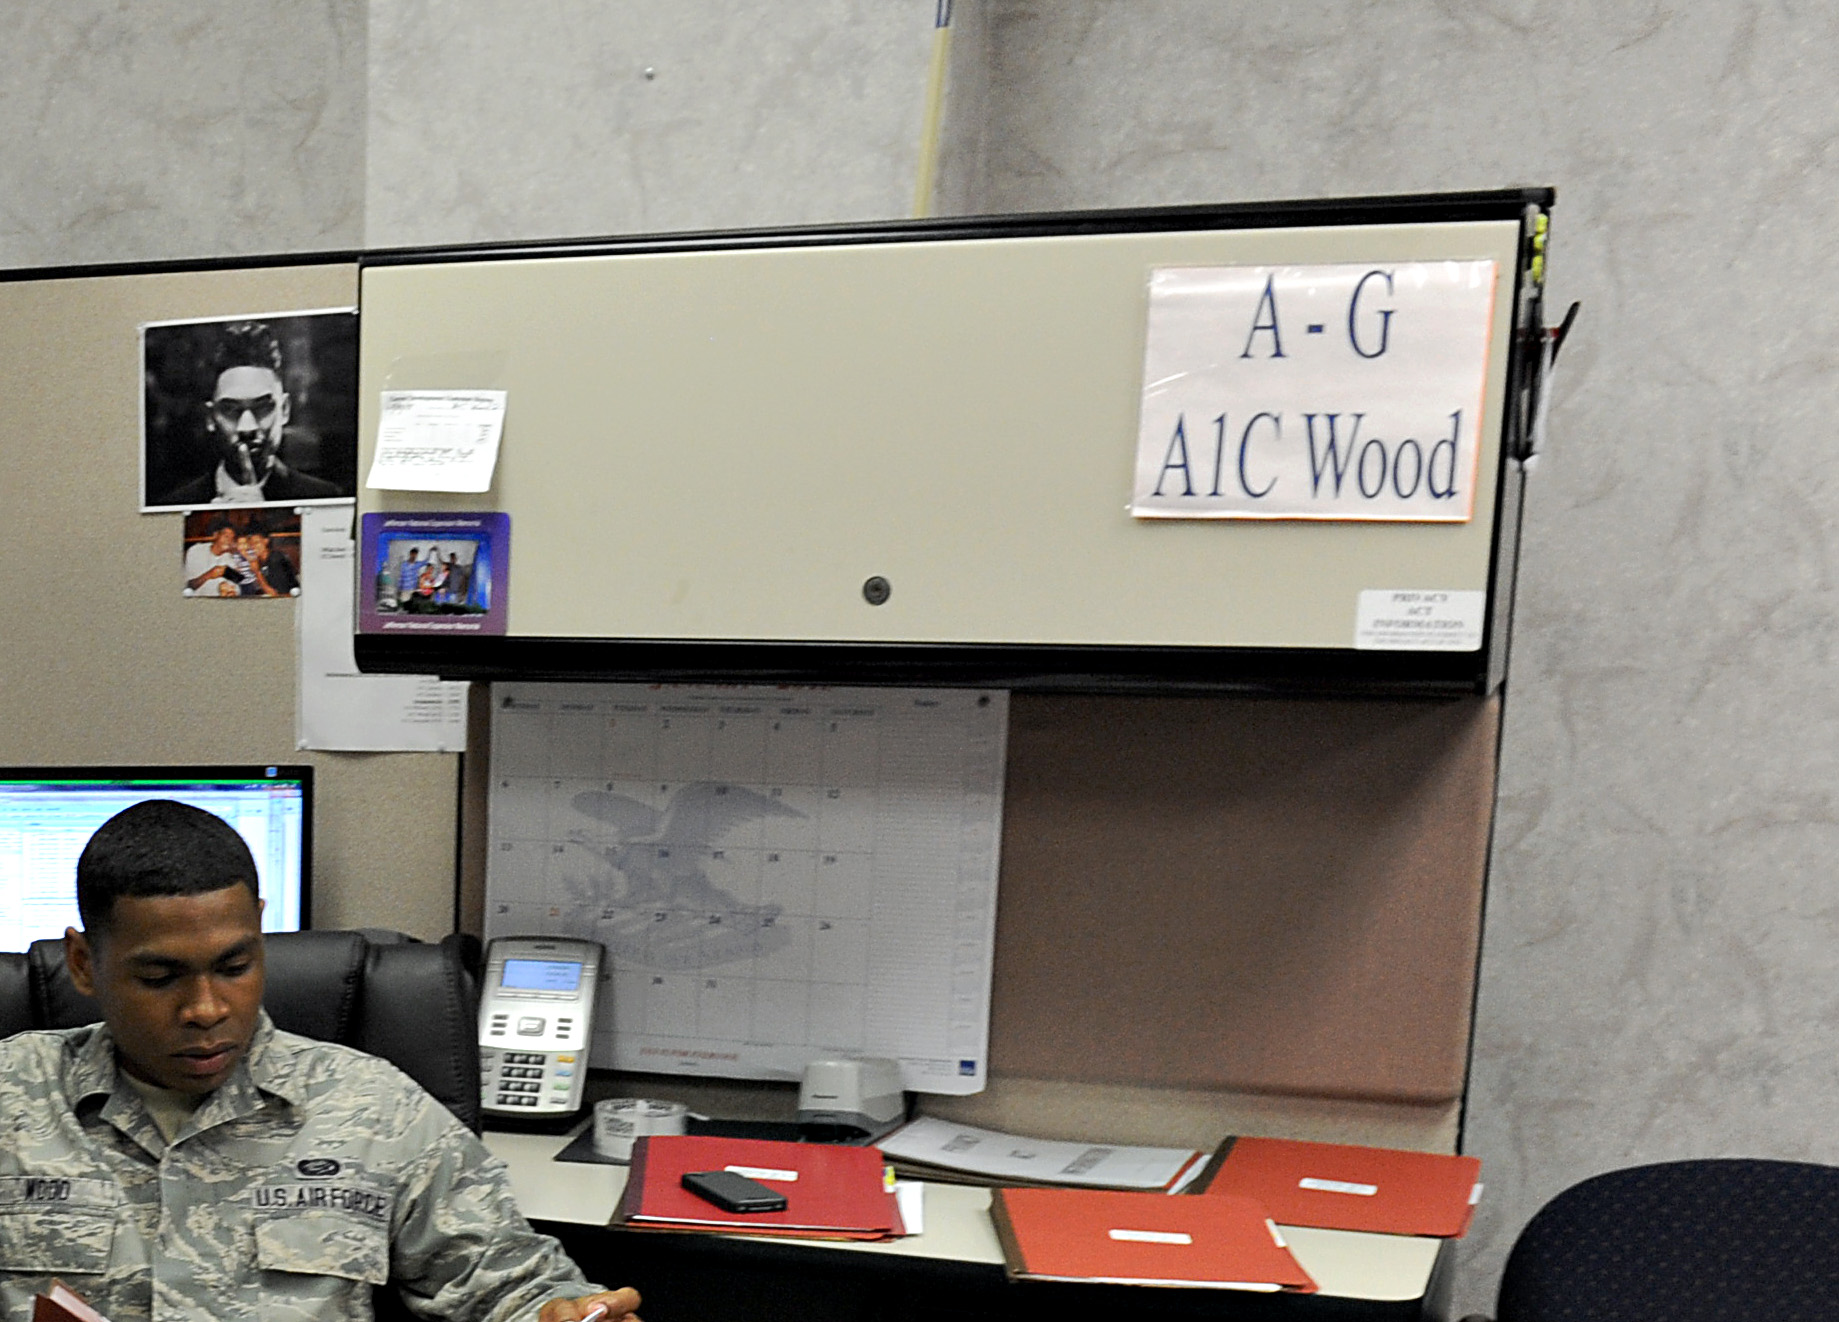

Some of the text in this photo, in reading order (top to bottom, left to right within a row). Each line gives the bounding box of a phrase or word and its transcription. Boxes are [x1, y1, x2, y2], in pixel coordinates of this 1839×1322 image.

[1238, 269, 1397, 359] A - G
[1301, 408, 1464, 501] Wood
[295, 1187, 327, 1208] AIR
[329, 1186, 388, 1218] FORCE
